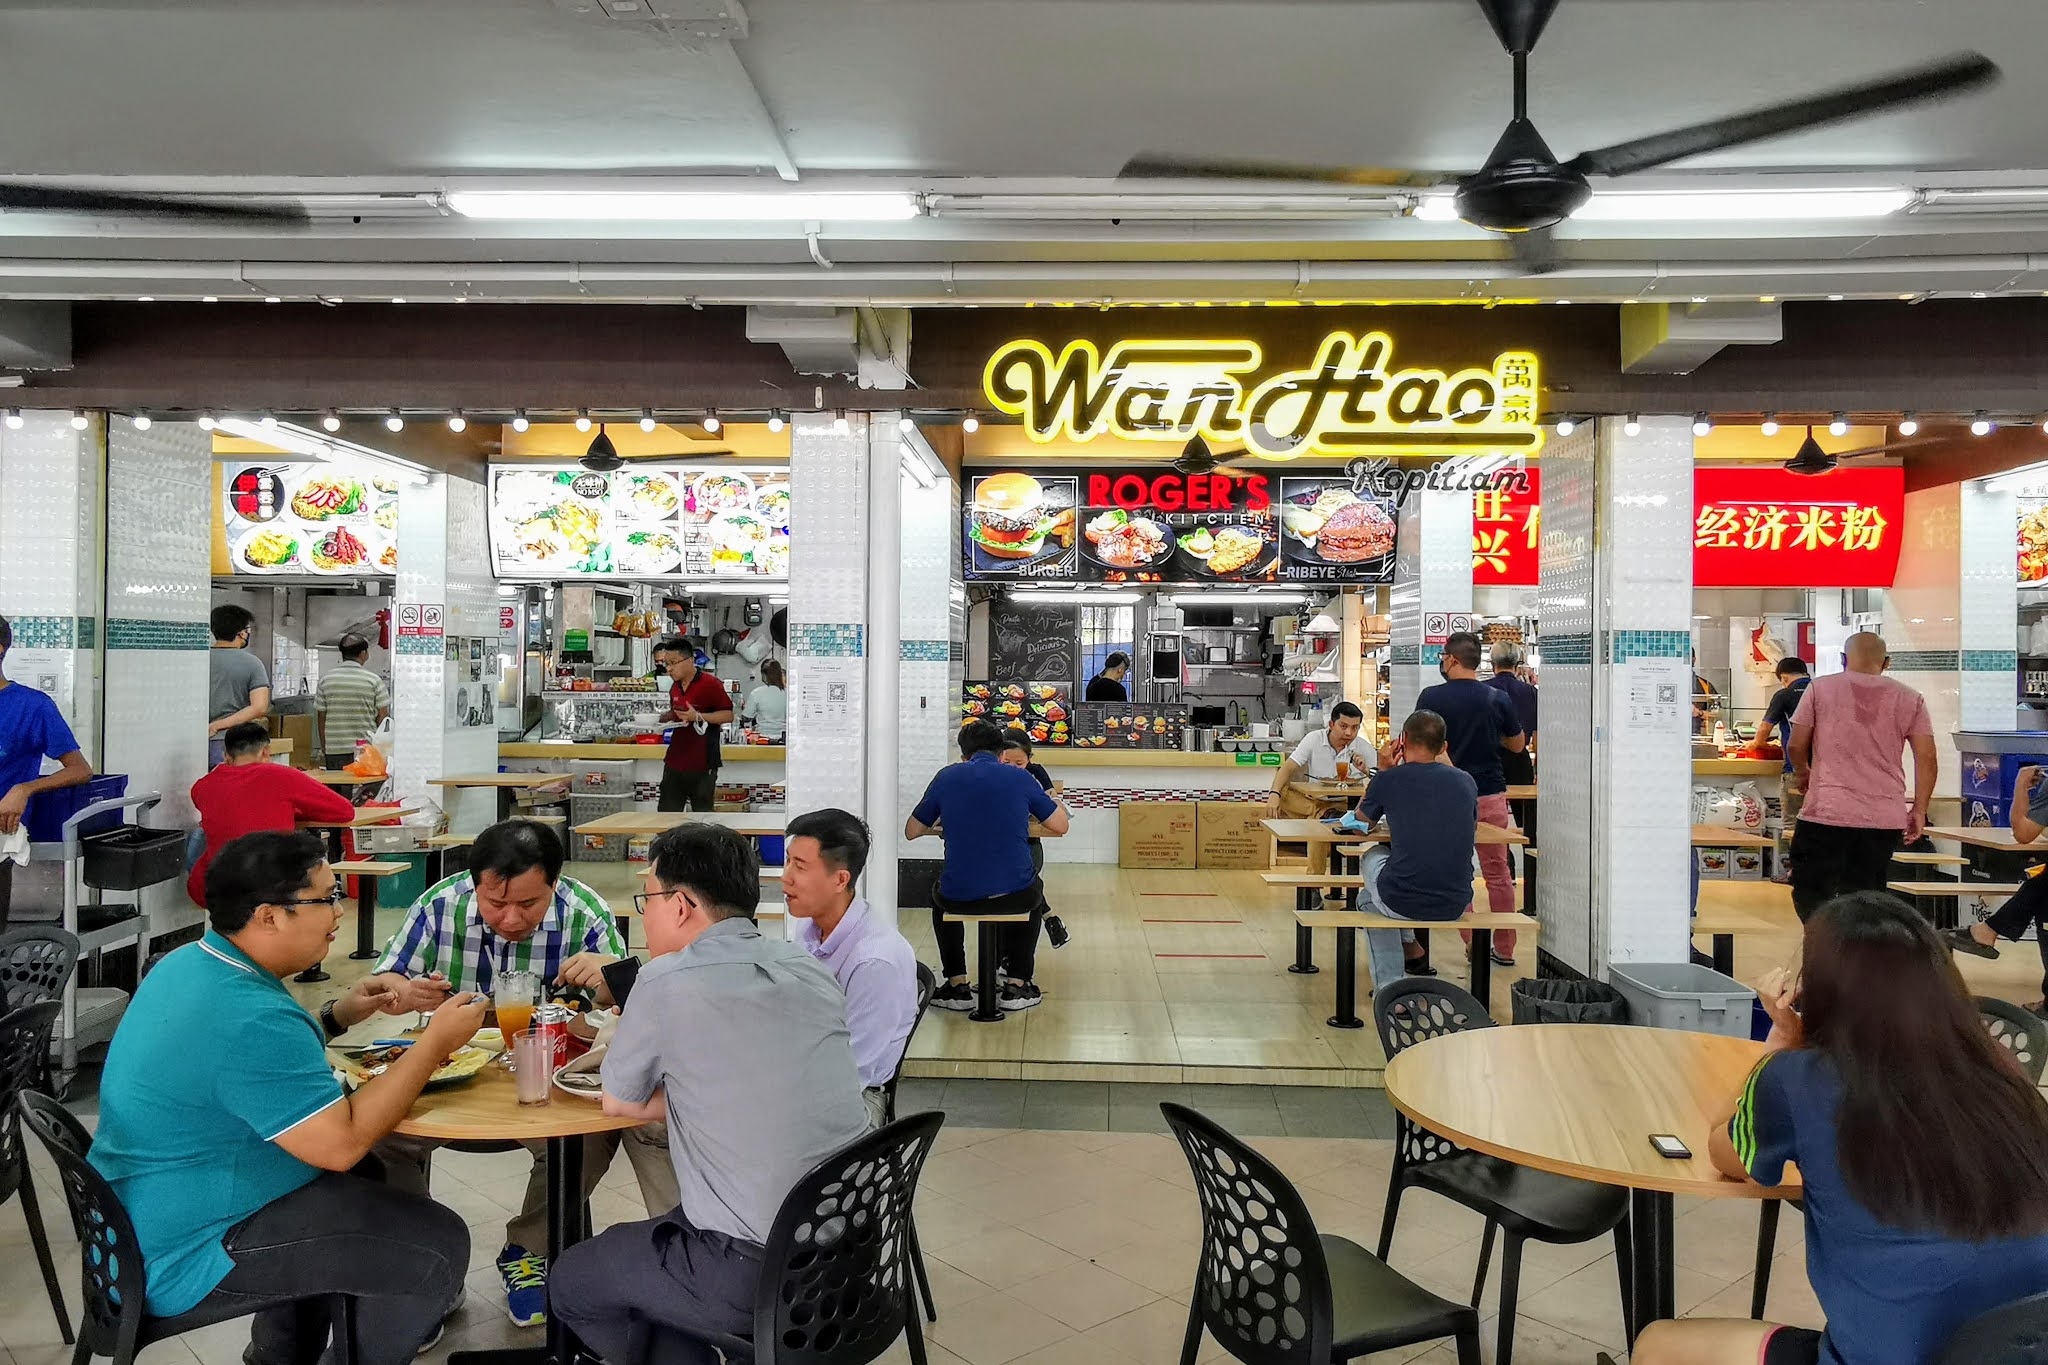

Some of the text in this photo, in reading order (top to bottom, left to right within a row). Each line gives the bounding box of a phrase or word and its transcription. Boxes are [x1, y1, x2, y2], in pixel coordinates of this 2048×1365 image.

[986, 333, 1501, 457] Wan Hao
[1089, 474, 1271, 511] ROGER'S
[1346, 456, 1531, 509] Kopitiam
[1165, 513, 1264, 525] KITCHEN
[1693, 505, 1888, 551] 经济米粉
[1018, 564, 1074, 577] BURGER
[1286, 566, 1336, 579] RIBEYE
[995, 661, 1017, 677] Beef
